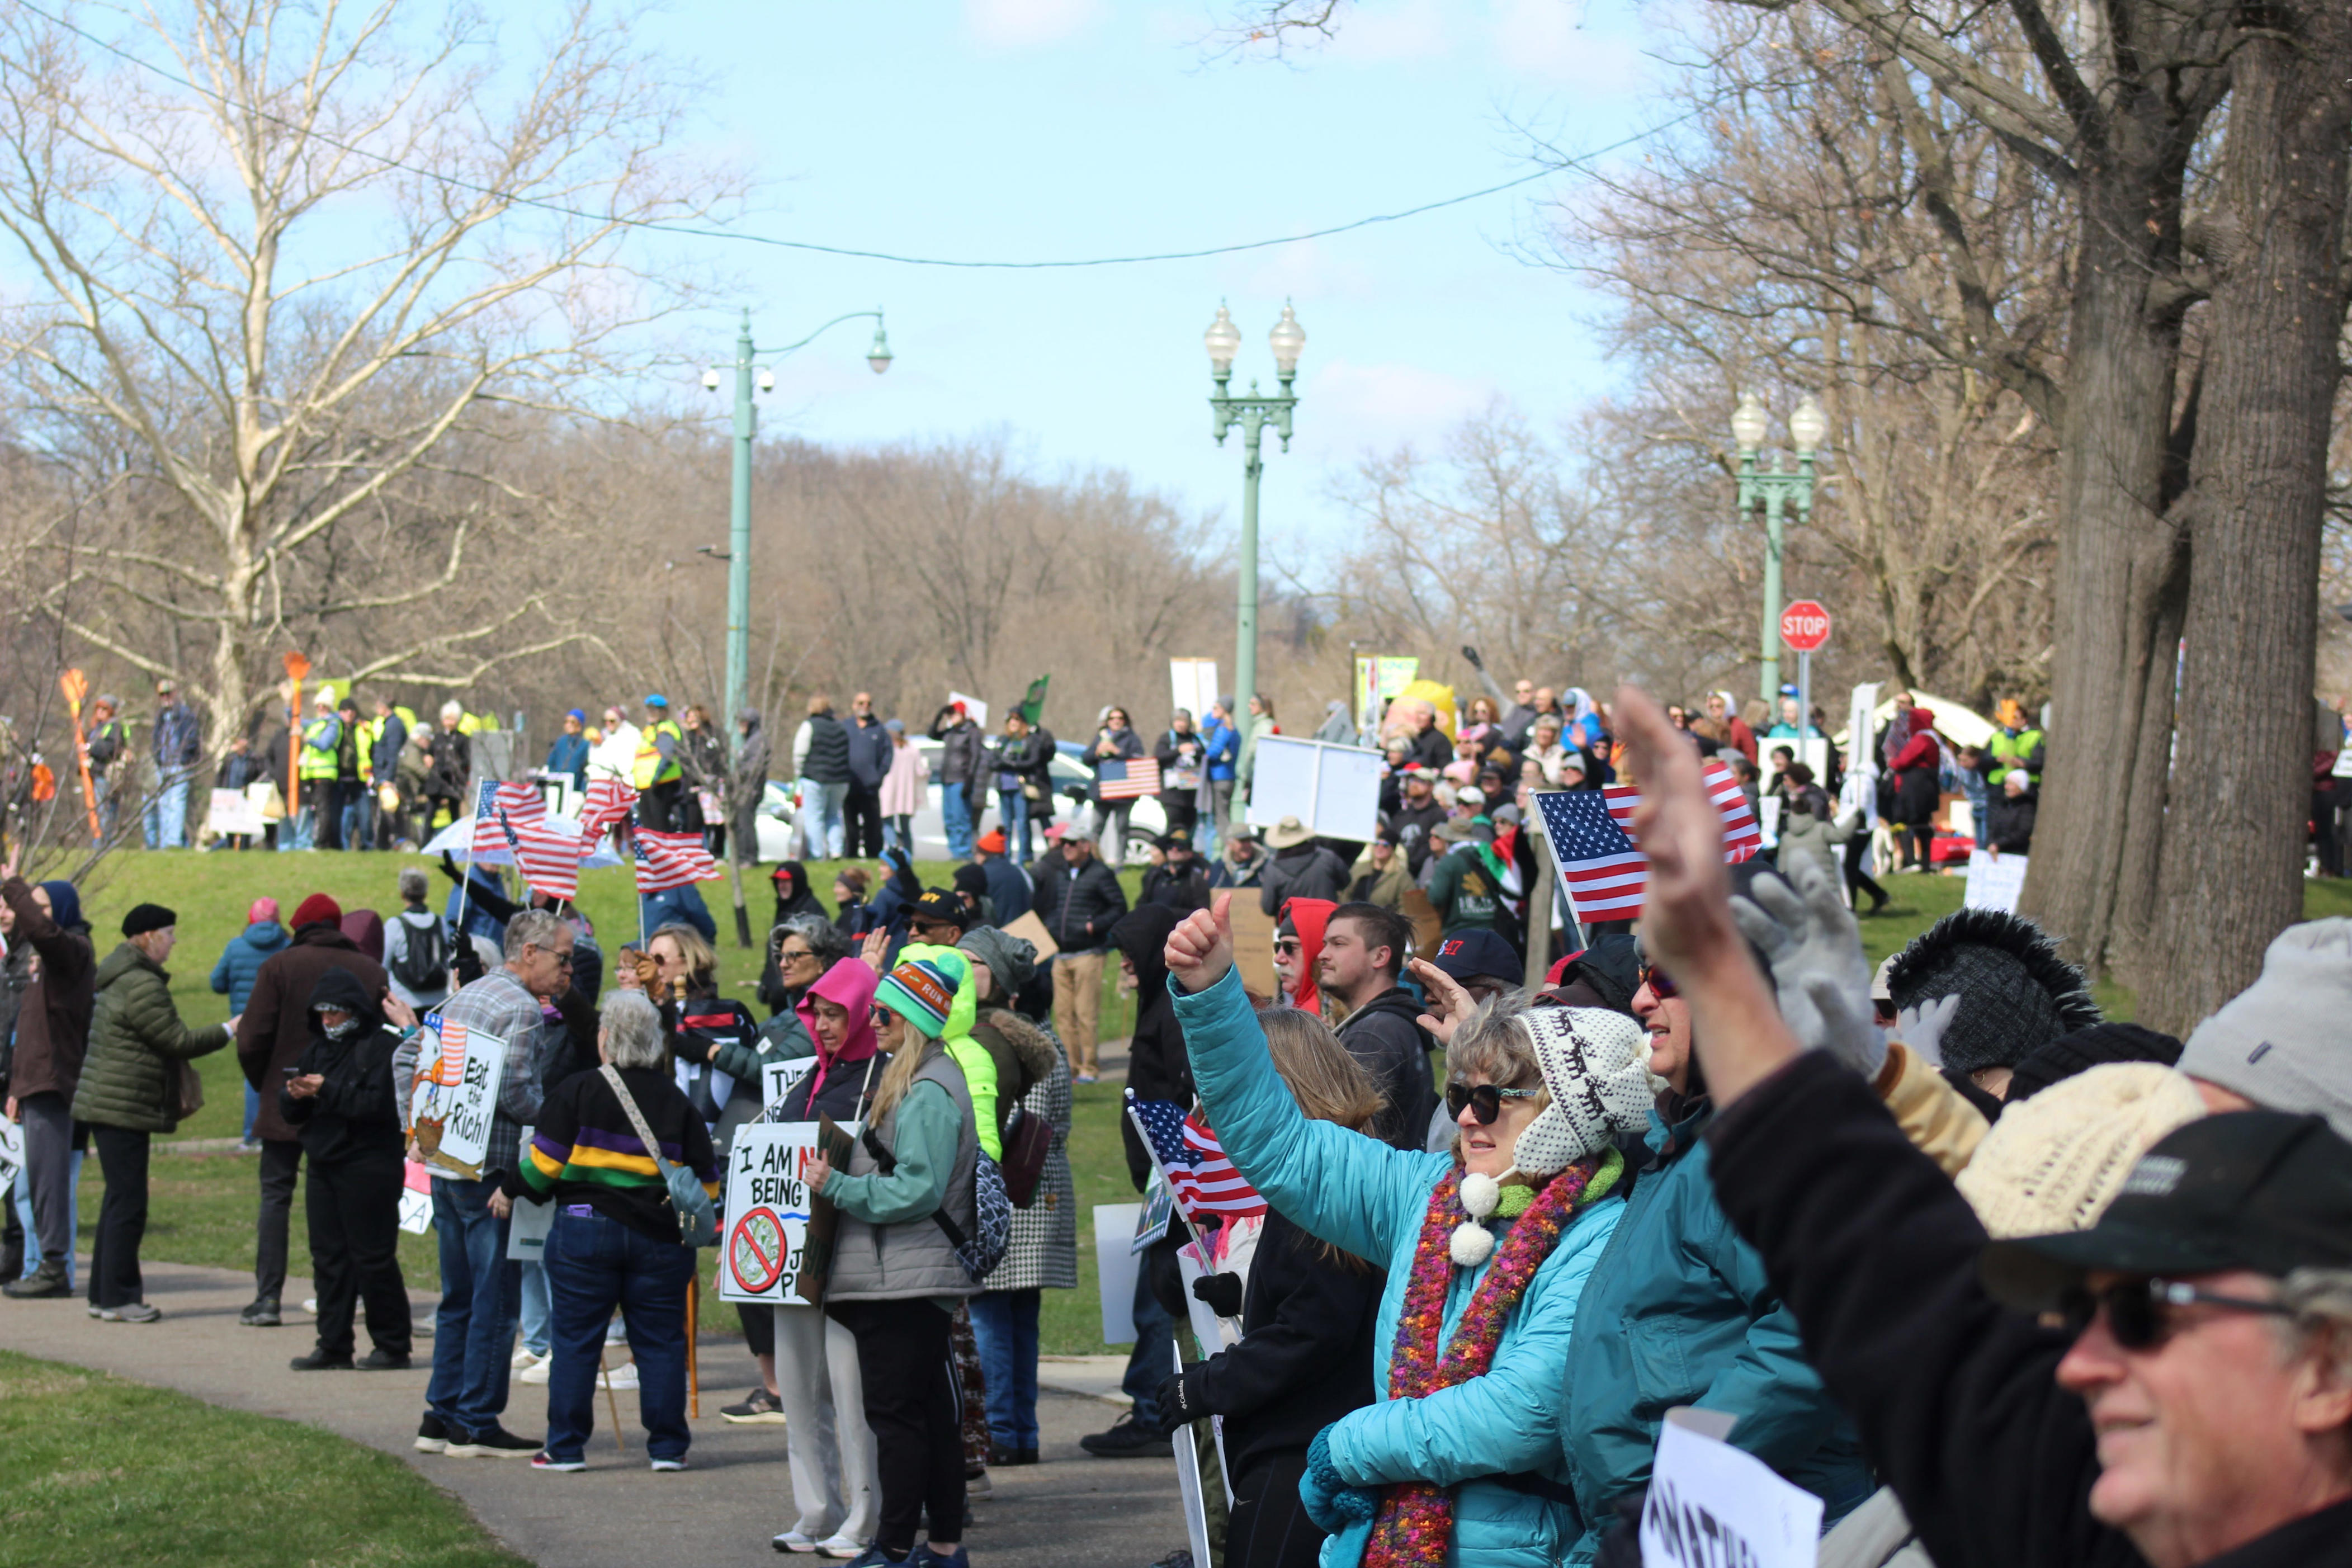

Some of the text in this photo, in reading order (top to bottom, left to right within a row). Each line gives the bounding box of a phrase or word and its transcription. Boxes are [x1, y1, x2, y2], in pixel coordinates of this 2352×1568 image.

[1783, 616, 1826, 636] STOP
[922, 983, 943, 1005] RUN
[465, 1056, 489, 1090] Eat
[468, 1087, 482, 1108] the
[451, 1101, 490, 1150] Rich!
[740, 1145, 753, 1173] I
[761, 1142, 792, 1176] AM
[751, 1177, 802, 1207] BEING
